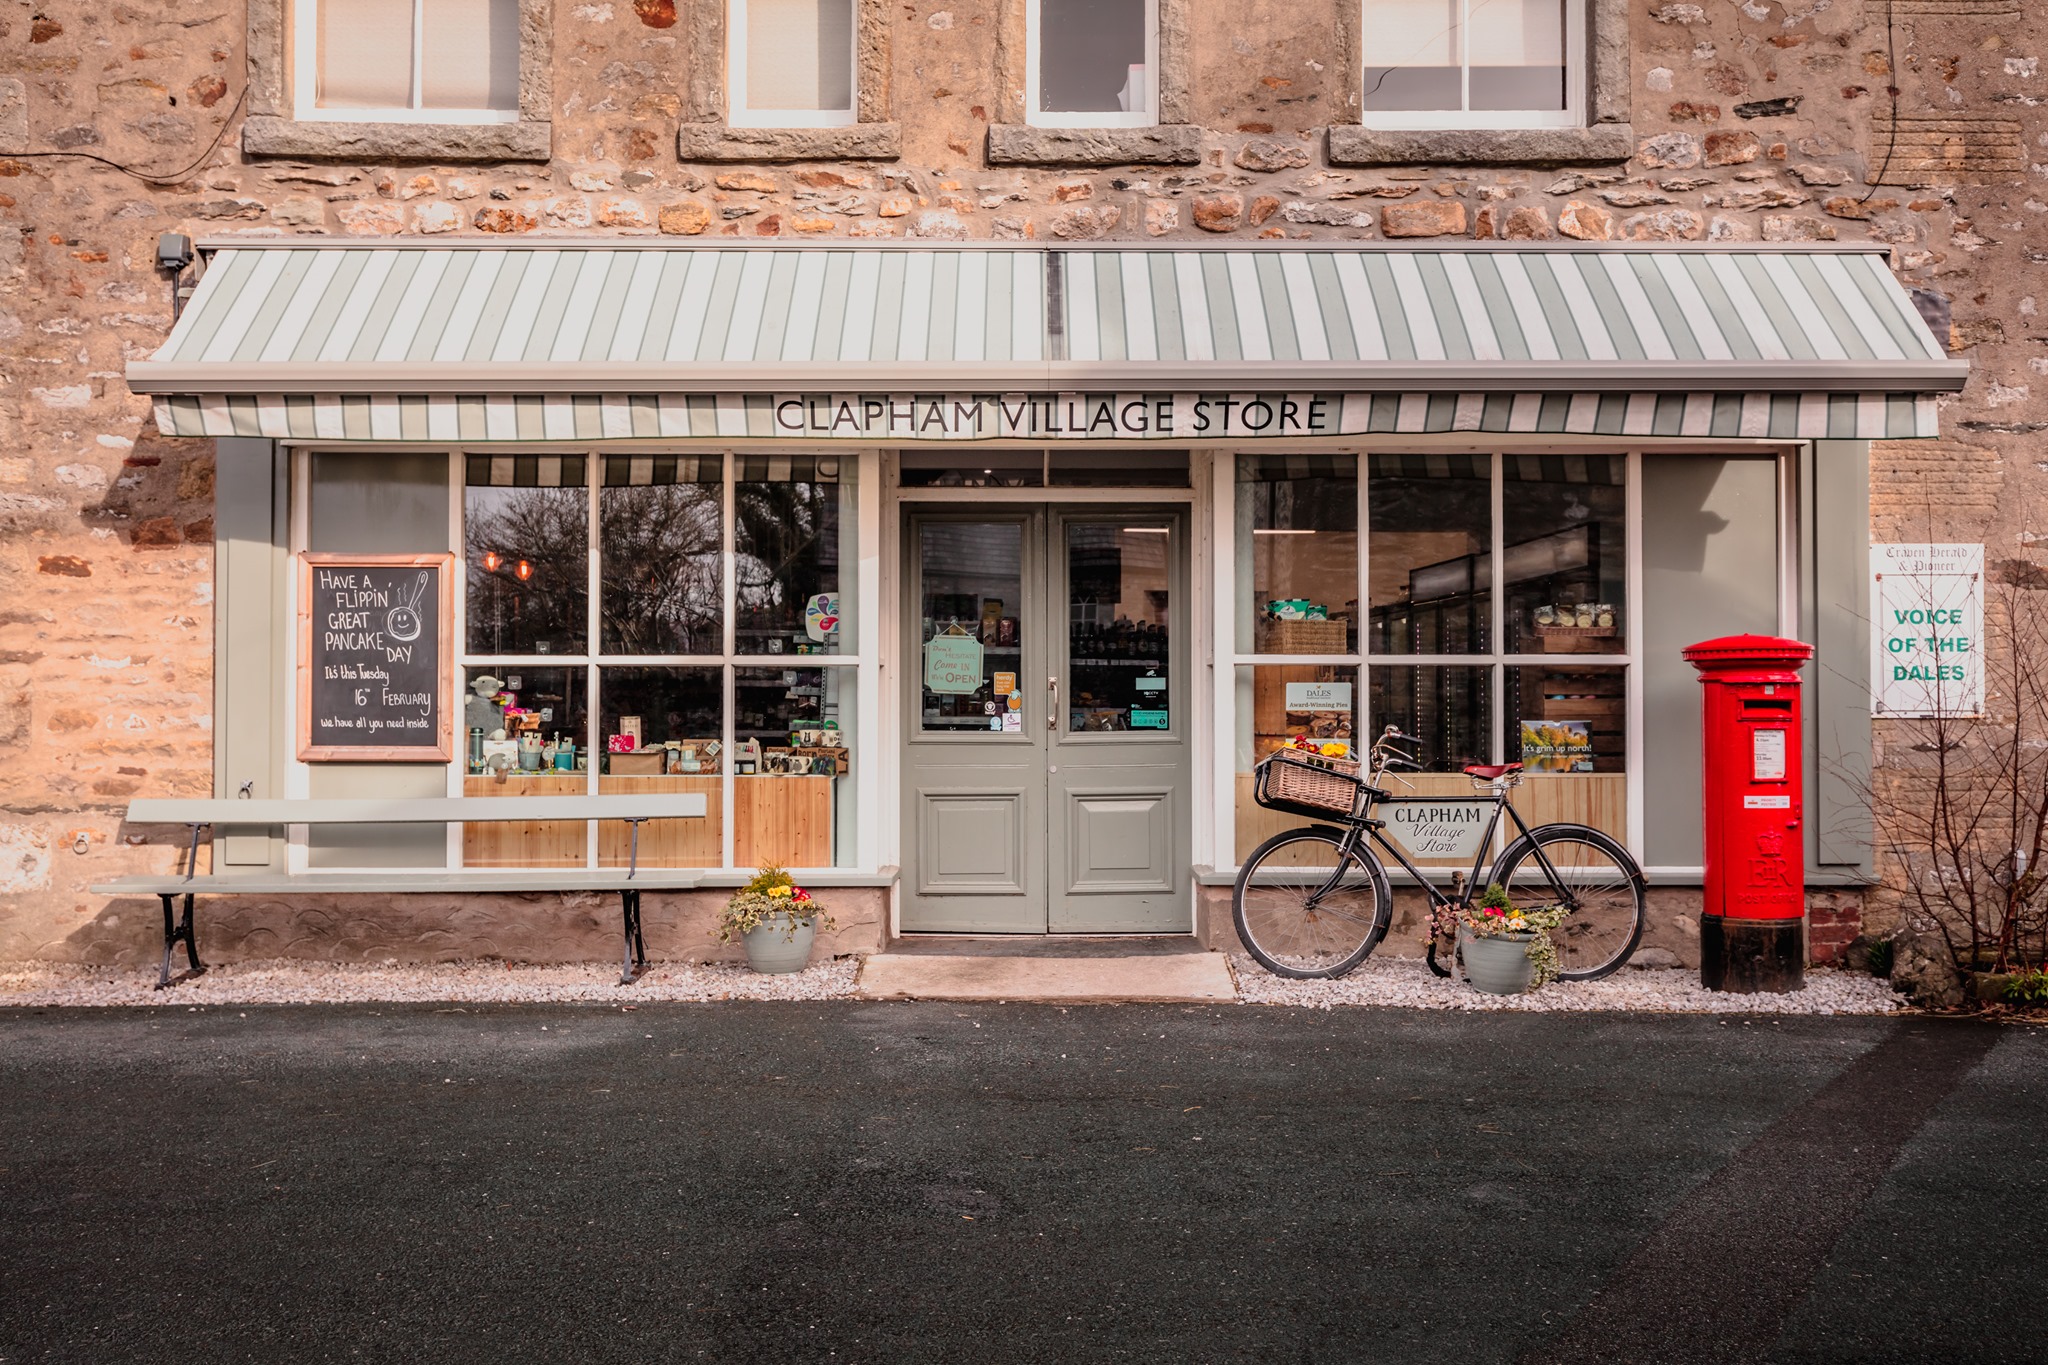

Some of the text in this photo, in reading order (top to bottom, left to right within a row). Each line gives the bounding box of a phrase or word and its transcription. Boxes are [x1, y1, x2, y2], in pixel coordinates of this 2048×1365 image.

[775, 399, 1327, 432] CLAPHAM VILLAGE STORE
[1913, 560, 1956, 573] Pioneer
[320, 570, 372, 589] HAVE A
[328, 612, 371, 630] GREAT
[1893, 609, 1963, 625] VOICE
[325, 631, 412, 664] PANCAKE DAY
[1888, 637, 1969, 653] OF THE
[934, 660, 957, 670] Come
[1893, 665, 1965, 681] DALES
[340, 664, 357, 680] this
[357, 663, 390, 687] Tuesday
[945, 672, 976, 684] OPEN
[334, 716, 354, 728] have
[356, 717, 366, 728] all
[369, 720, 384, 734] you
[386, 717, 405, 728] need
[406, 717, 429, 728] inside
[1523, 744, 1592, 754] It's grim up north!
[1395, 808, 1480, 823] CLAPHAM
[1406, 822, 1465, 841] Village
[1416, 839, 1458, 852] Store
[1738, 893, 1767, 904] POST
